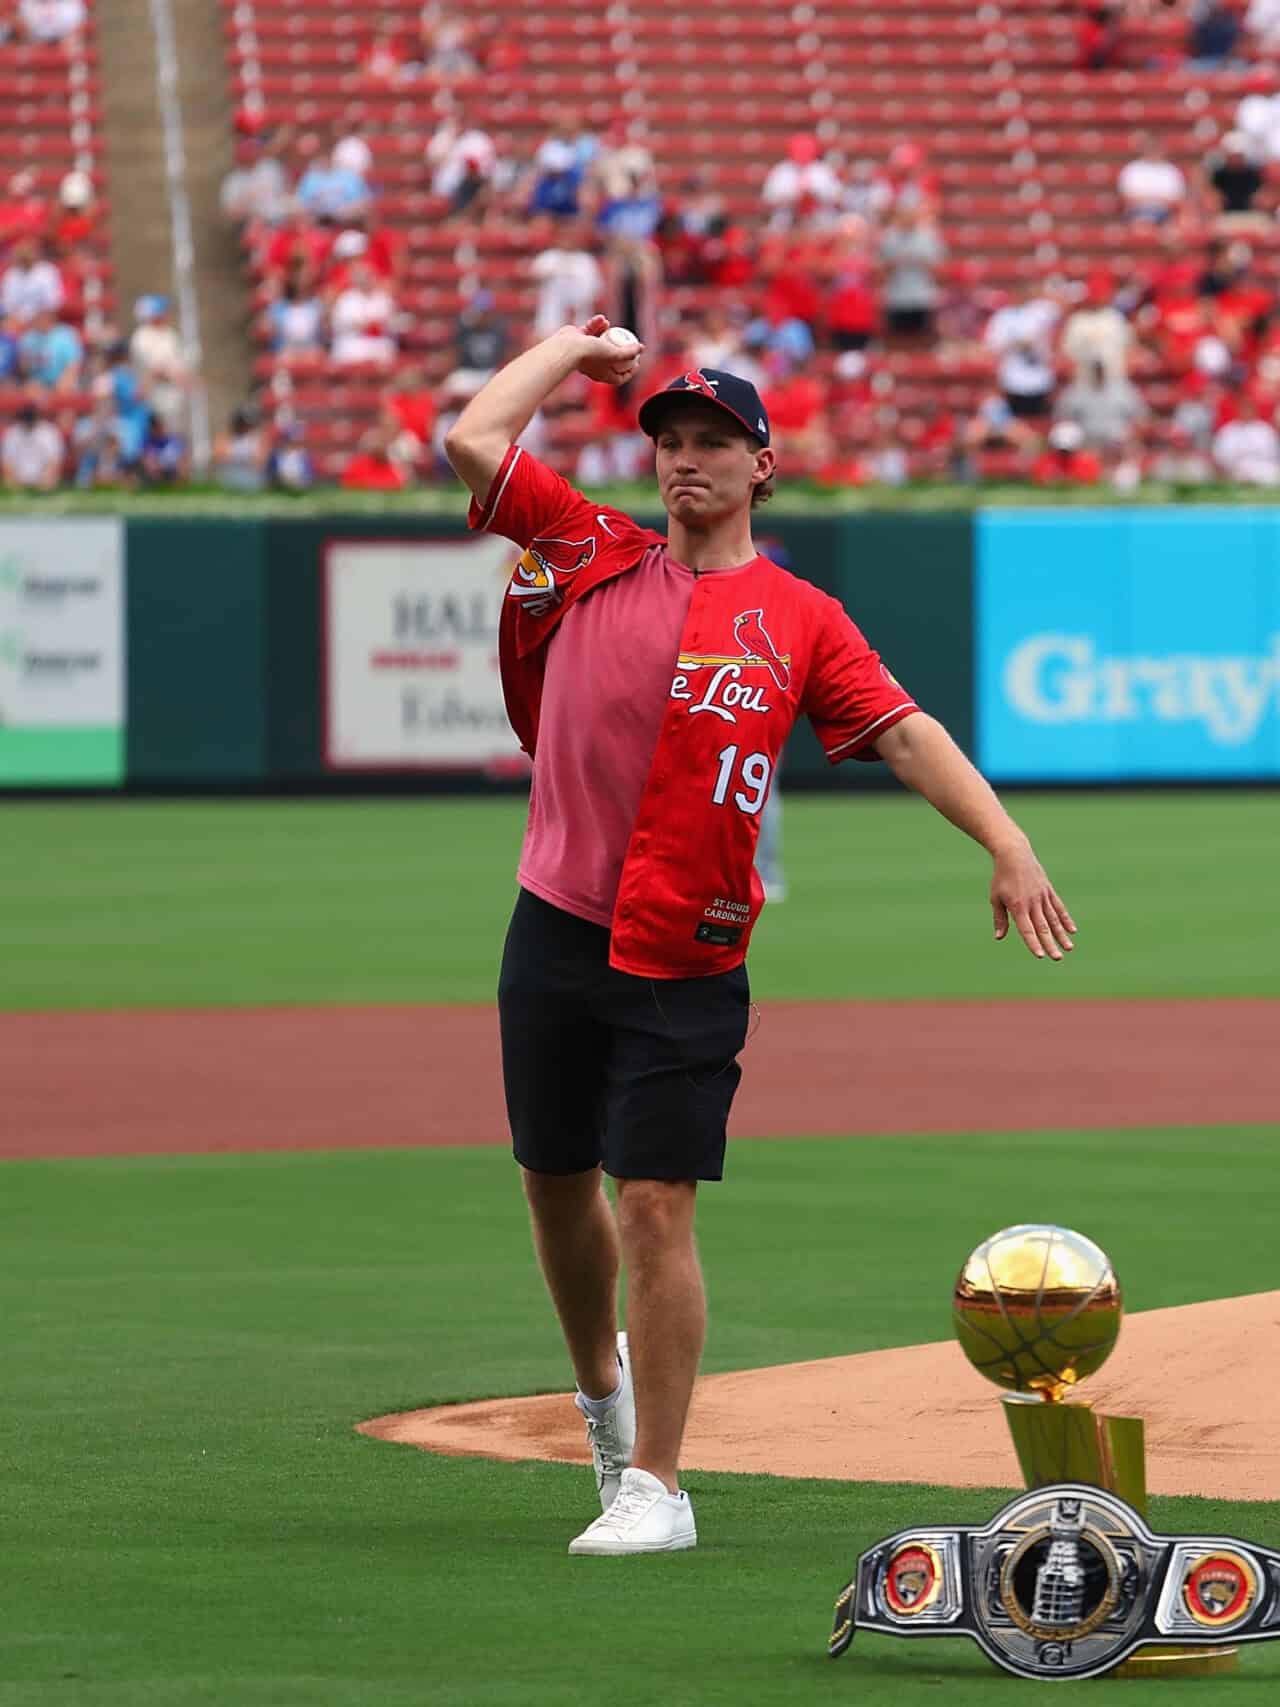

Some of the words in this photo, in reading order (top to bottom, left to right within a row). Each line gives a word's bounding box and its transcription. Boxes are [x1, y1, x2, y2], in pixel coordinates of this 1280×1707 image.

[687, 663, 771, 724] Lou
[711, 743, 772, 815] 19
[726, 900, 750, 913] LOUIS
